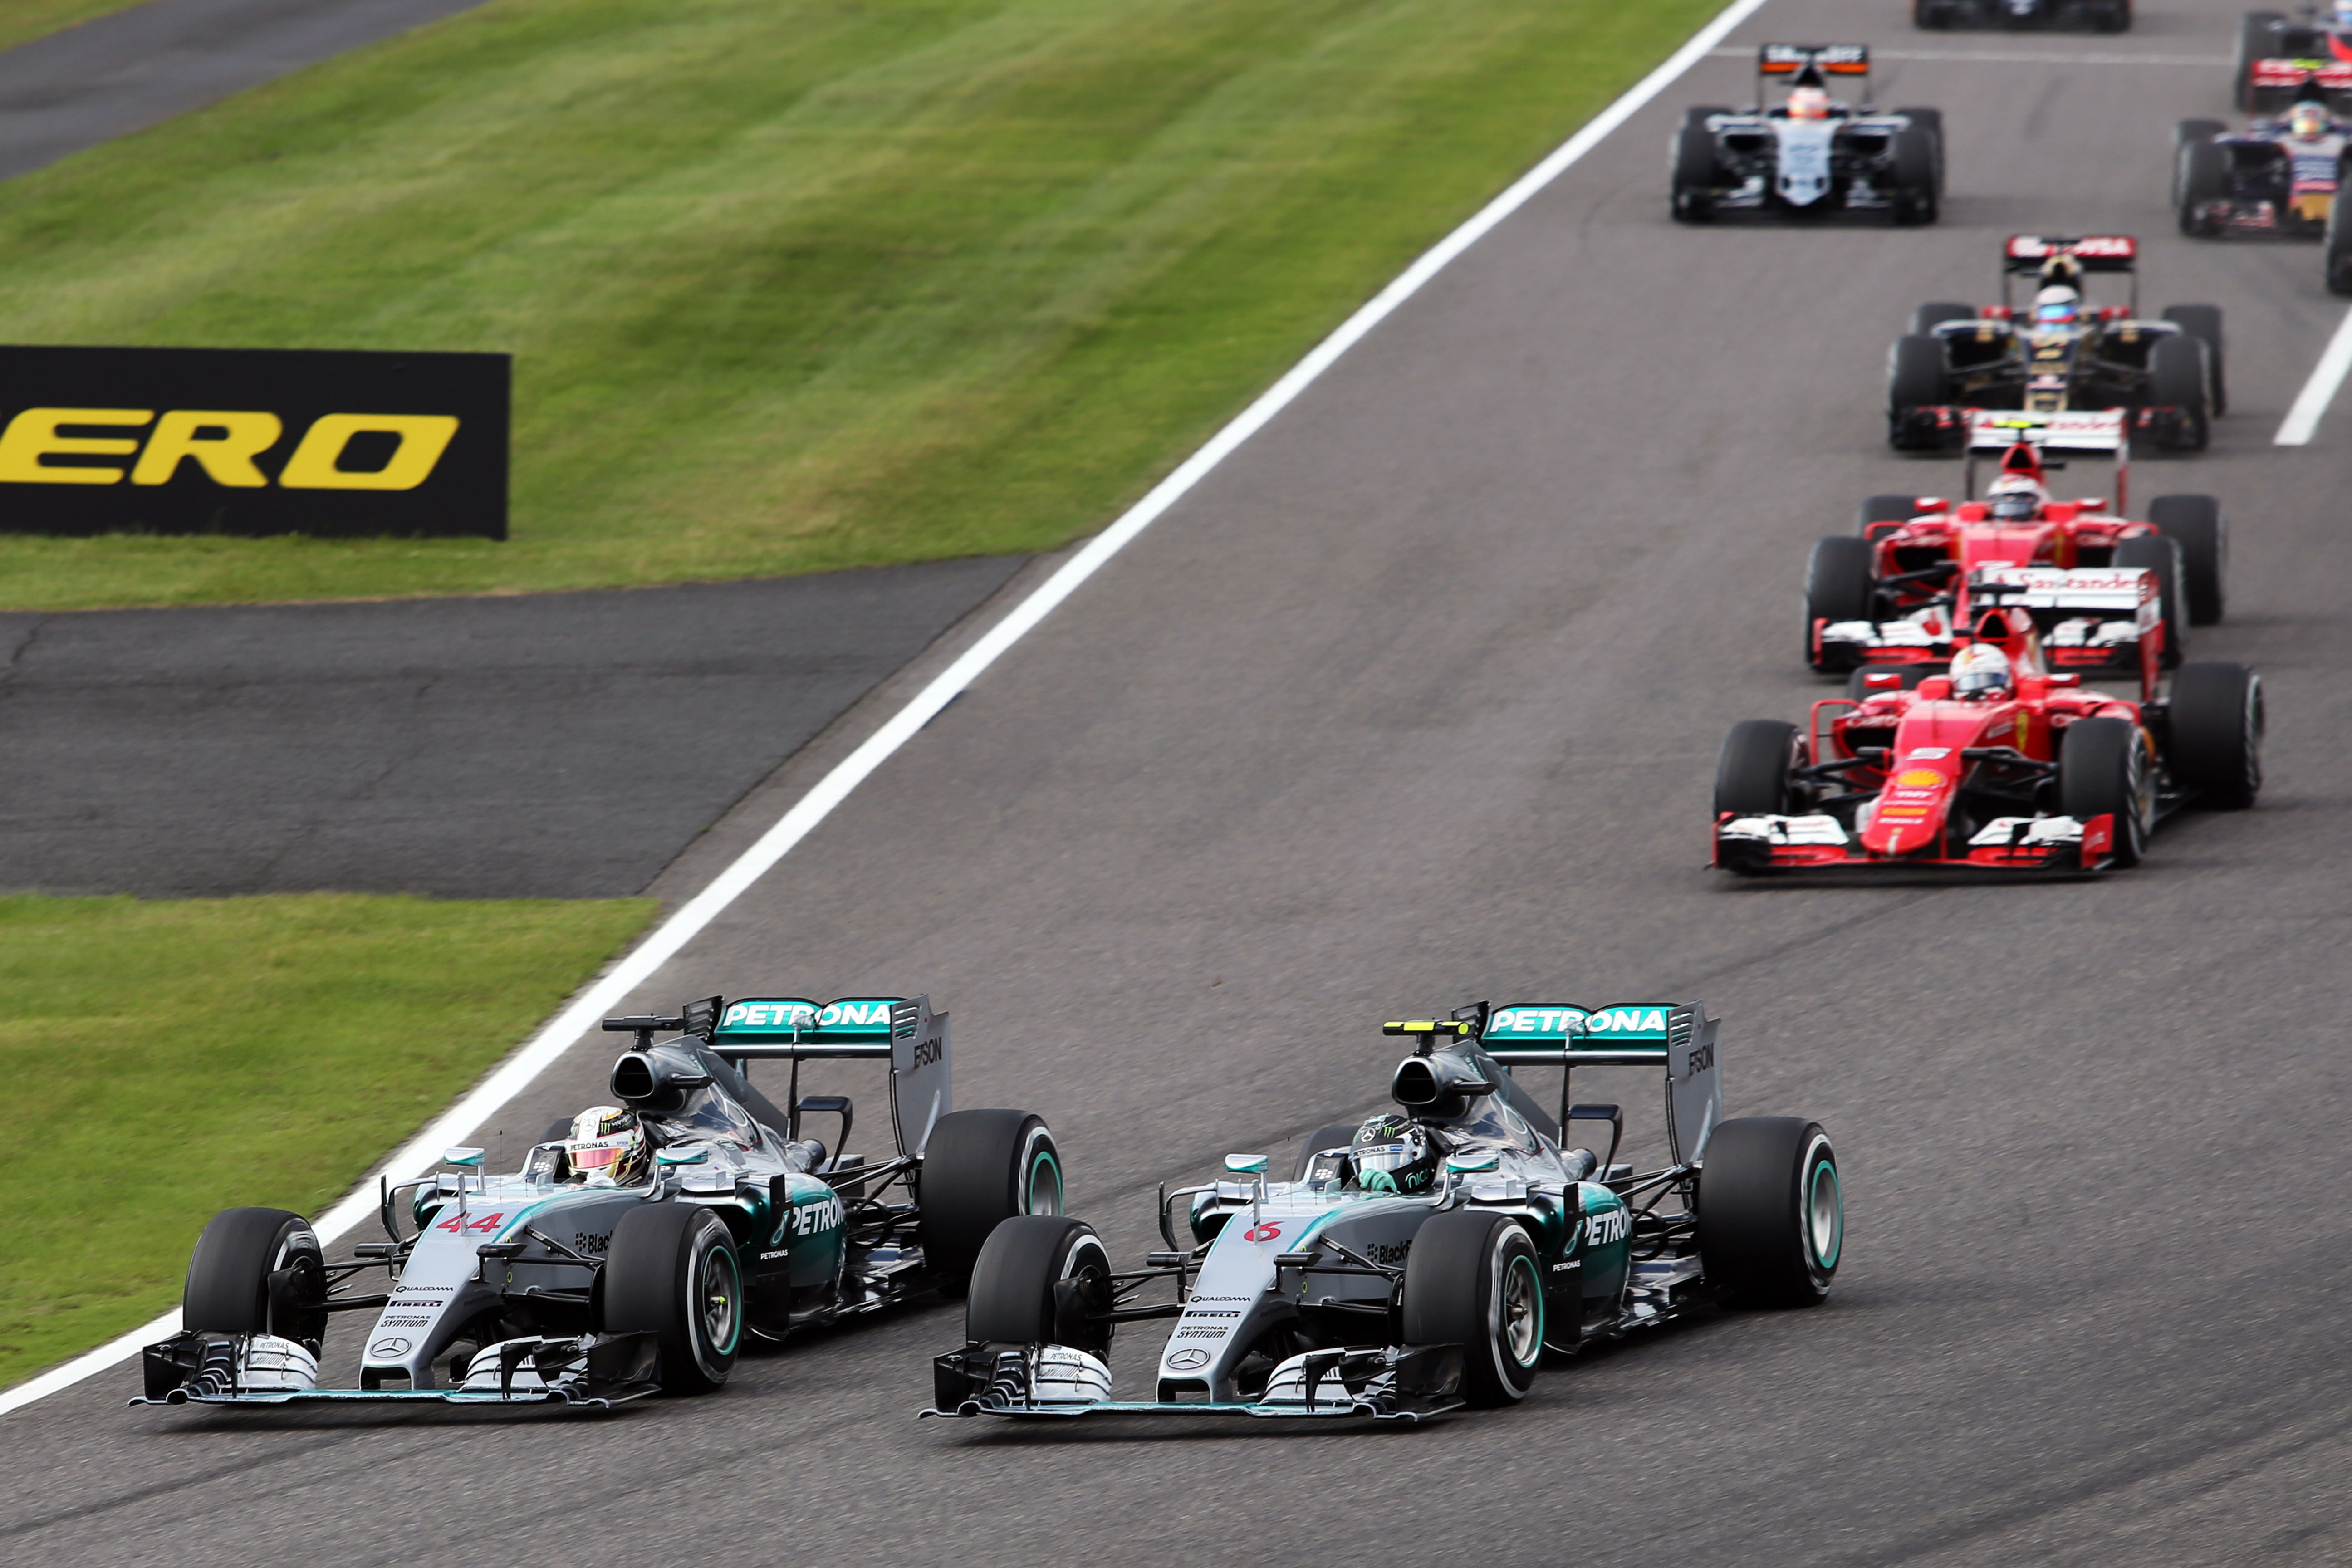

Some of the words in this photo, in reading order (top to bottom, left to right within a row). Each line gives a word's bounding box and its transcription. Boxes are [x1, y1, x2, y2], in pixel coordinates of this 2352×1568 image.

[0, 407, 460, 490] ERO
[570, 1141, 609, 1150] PETRONAS
[1353, 1146, 1385, 1157] PETRONAS
[436, 1213, 505, 1233] 44
[1244, 1221, 1285, 1241] 6
[588, 1230, 613, 1254] Blac
[760, 1249, 789, 1260] PETRONAS
[1553, 1260, 1581, 1272] PETRONAS
[1177, 1330, 1226, 1338] SYNTIUM
[259, 1341, 289, 1349] PETRONAS
[1049, 1353, 1082, 1361] PETRONAS
